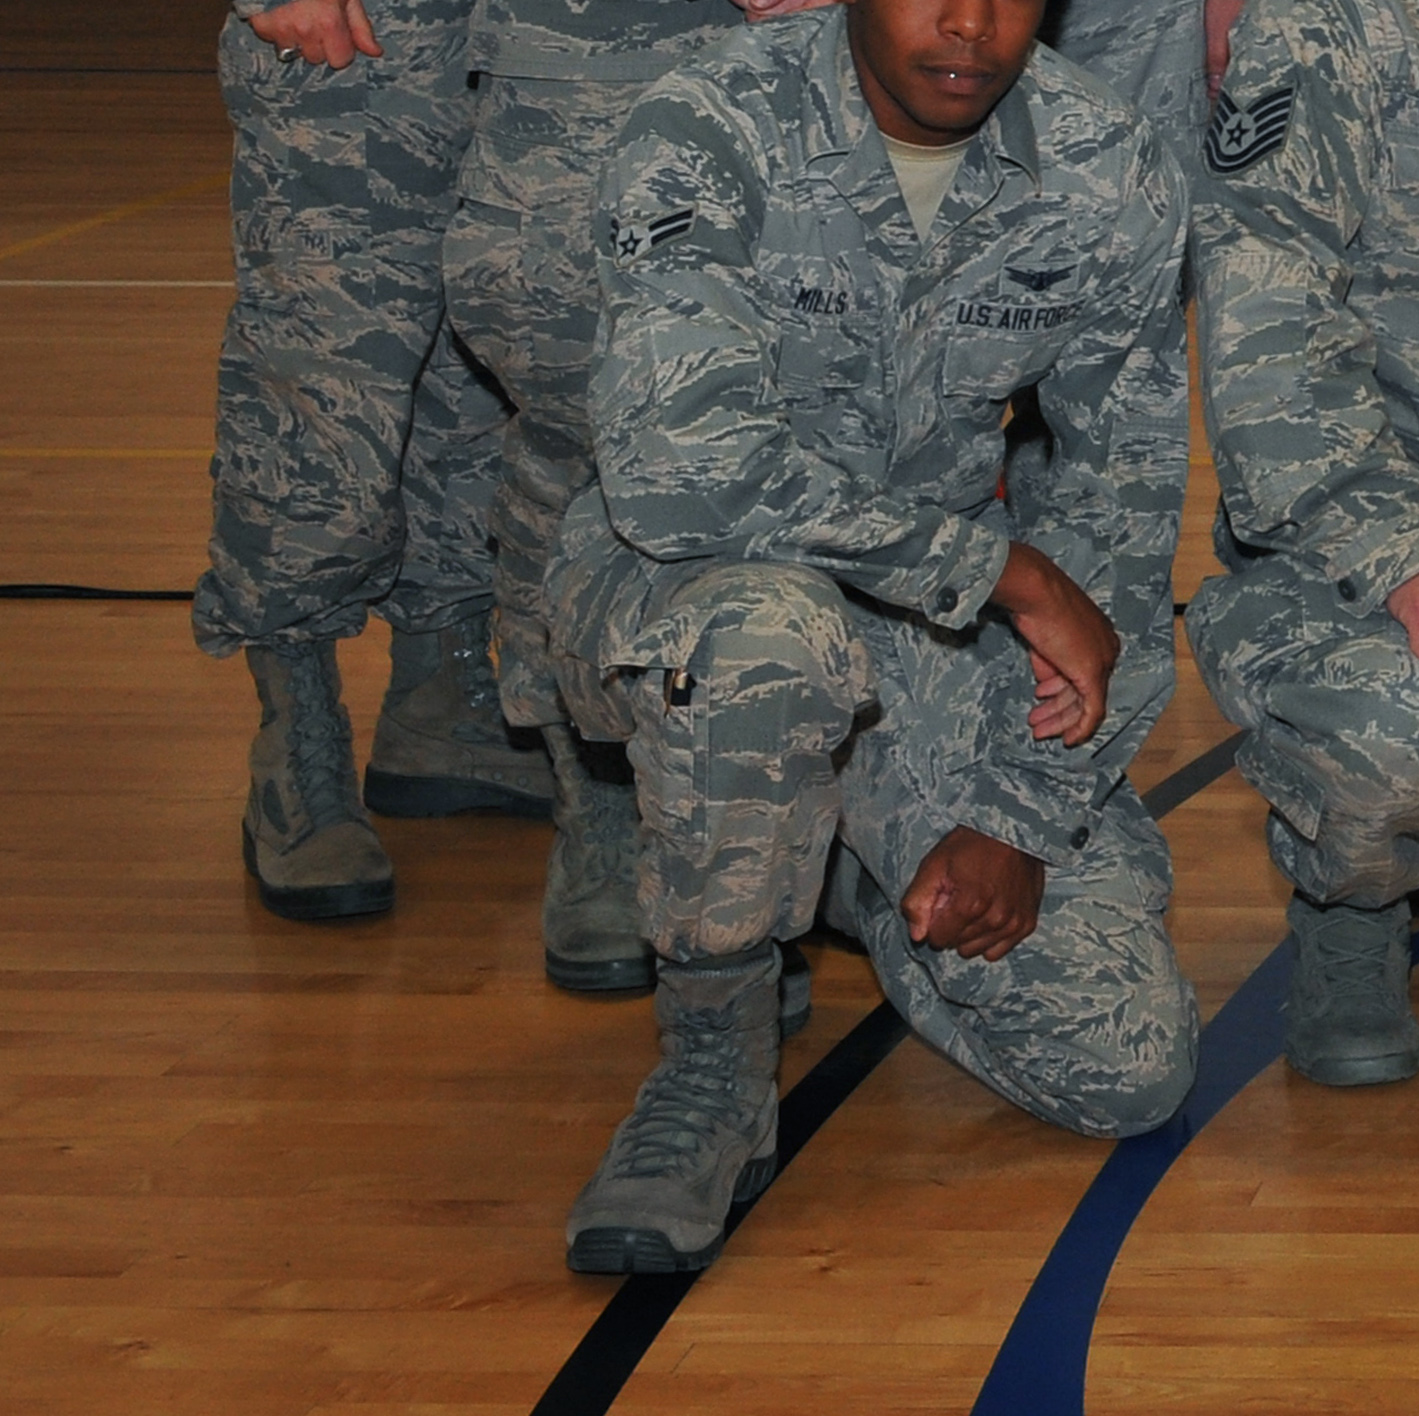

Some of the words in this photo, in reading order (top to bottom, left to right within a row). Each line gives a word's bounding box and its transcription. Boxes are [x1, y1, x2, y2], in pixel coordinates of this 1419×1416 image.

[794, 287, 848, 314] MILLS
[957, 303, 993, 328] U.S.
[997, 307, 1032, 330] AIR
